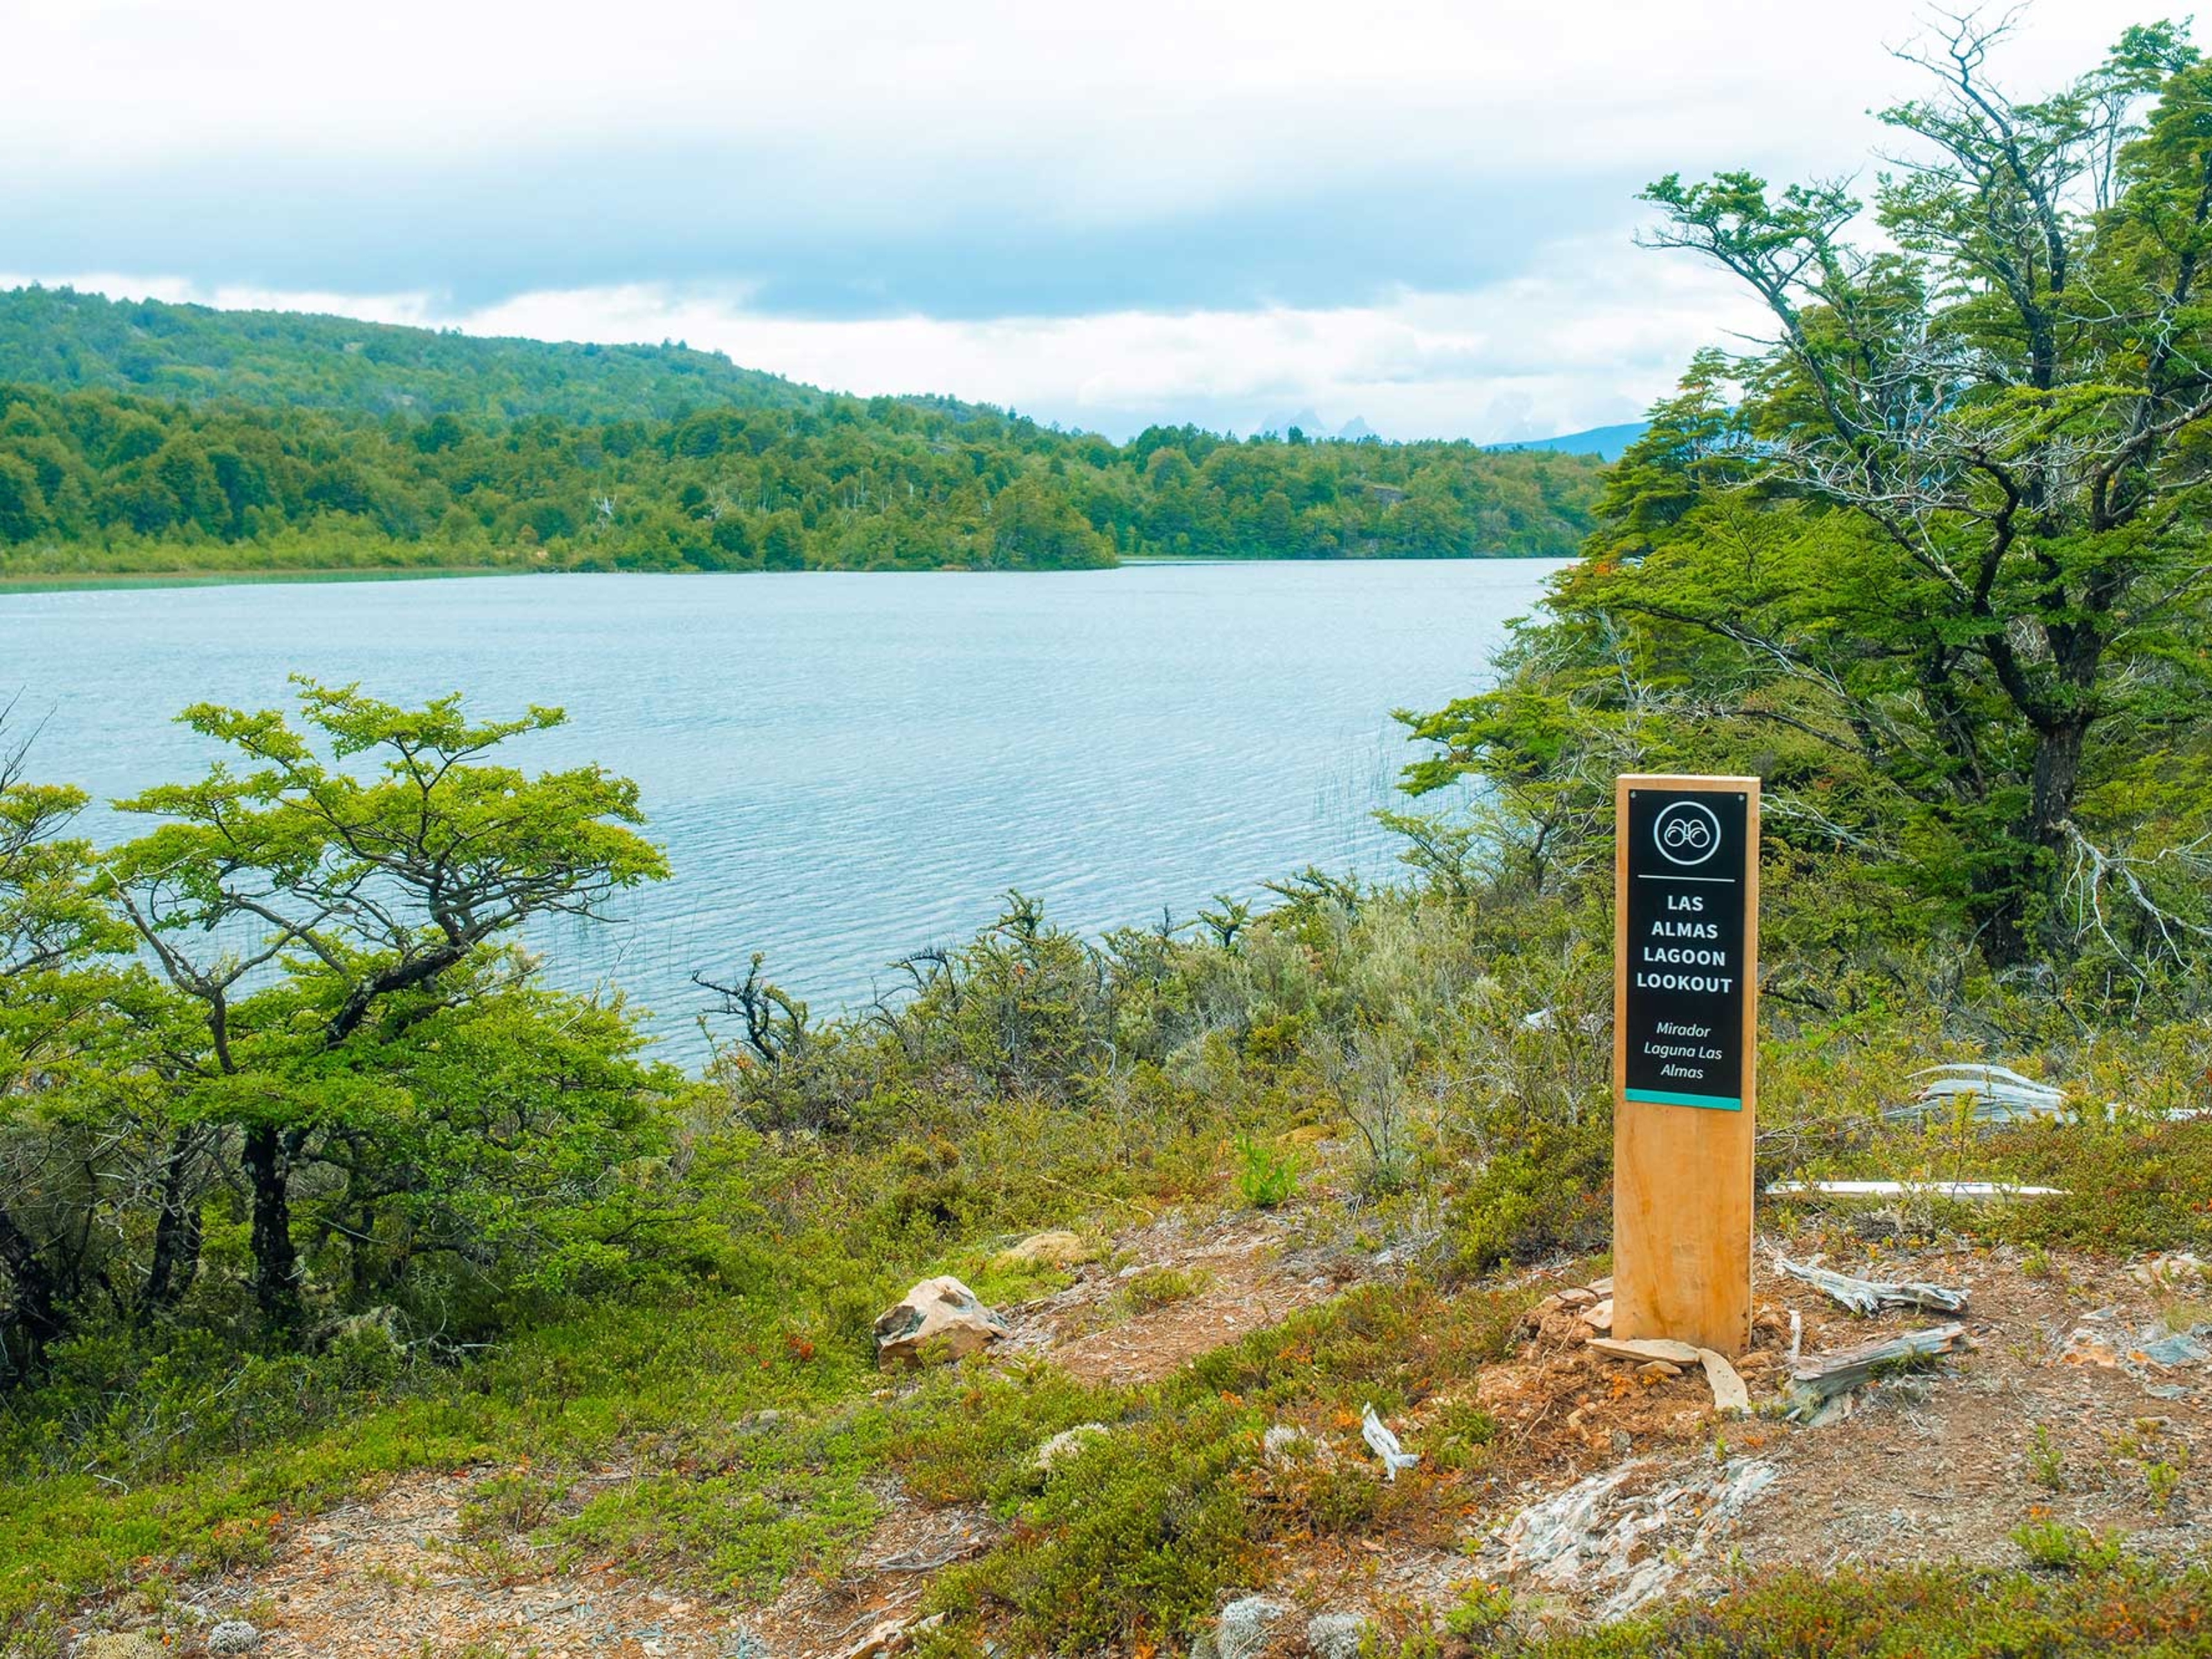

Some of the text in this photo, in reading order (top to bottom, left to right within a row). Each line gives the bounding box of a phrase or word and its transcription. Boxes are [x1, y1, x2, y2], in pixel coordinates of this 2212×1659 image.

[1668, 896, 1703, 911] LAS
[1651, 921, 1718, 939] ALMAS
[1644, 947, 1725, 966] LAGOON
[1638, 973, 1732, 993] LOOKOUT
[1657, 1022, 1711, 1037] Mirador
[1644, 1042, 1722, 1059] Laguna Las
[1660, 1064, 1703, 1078] Almas
